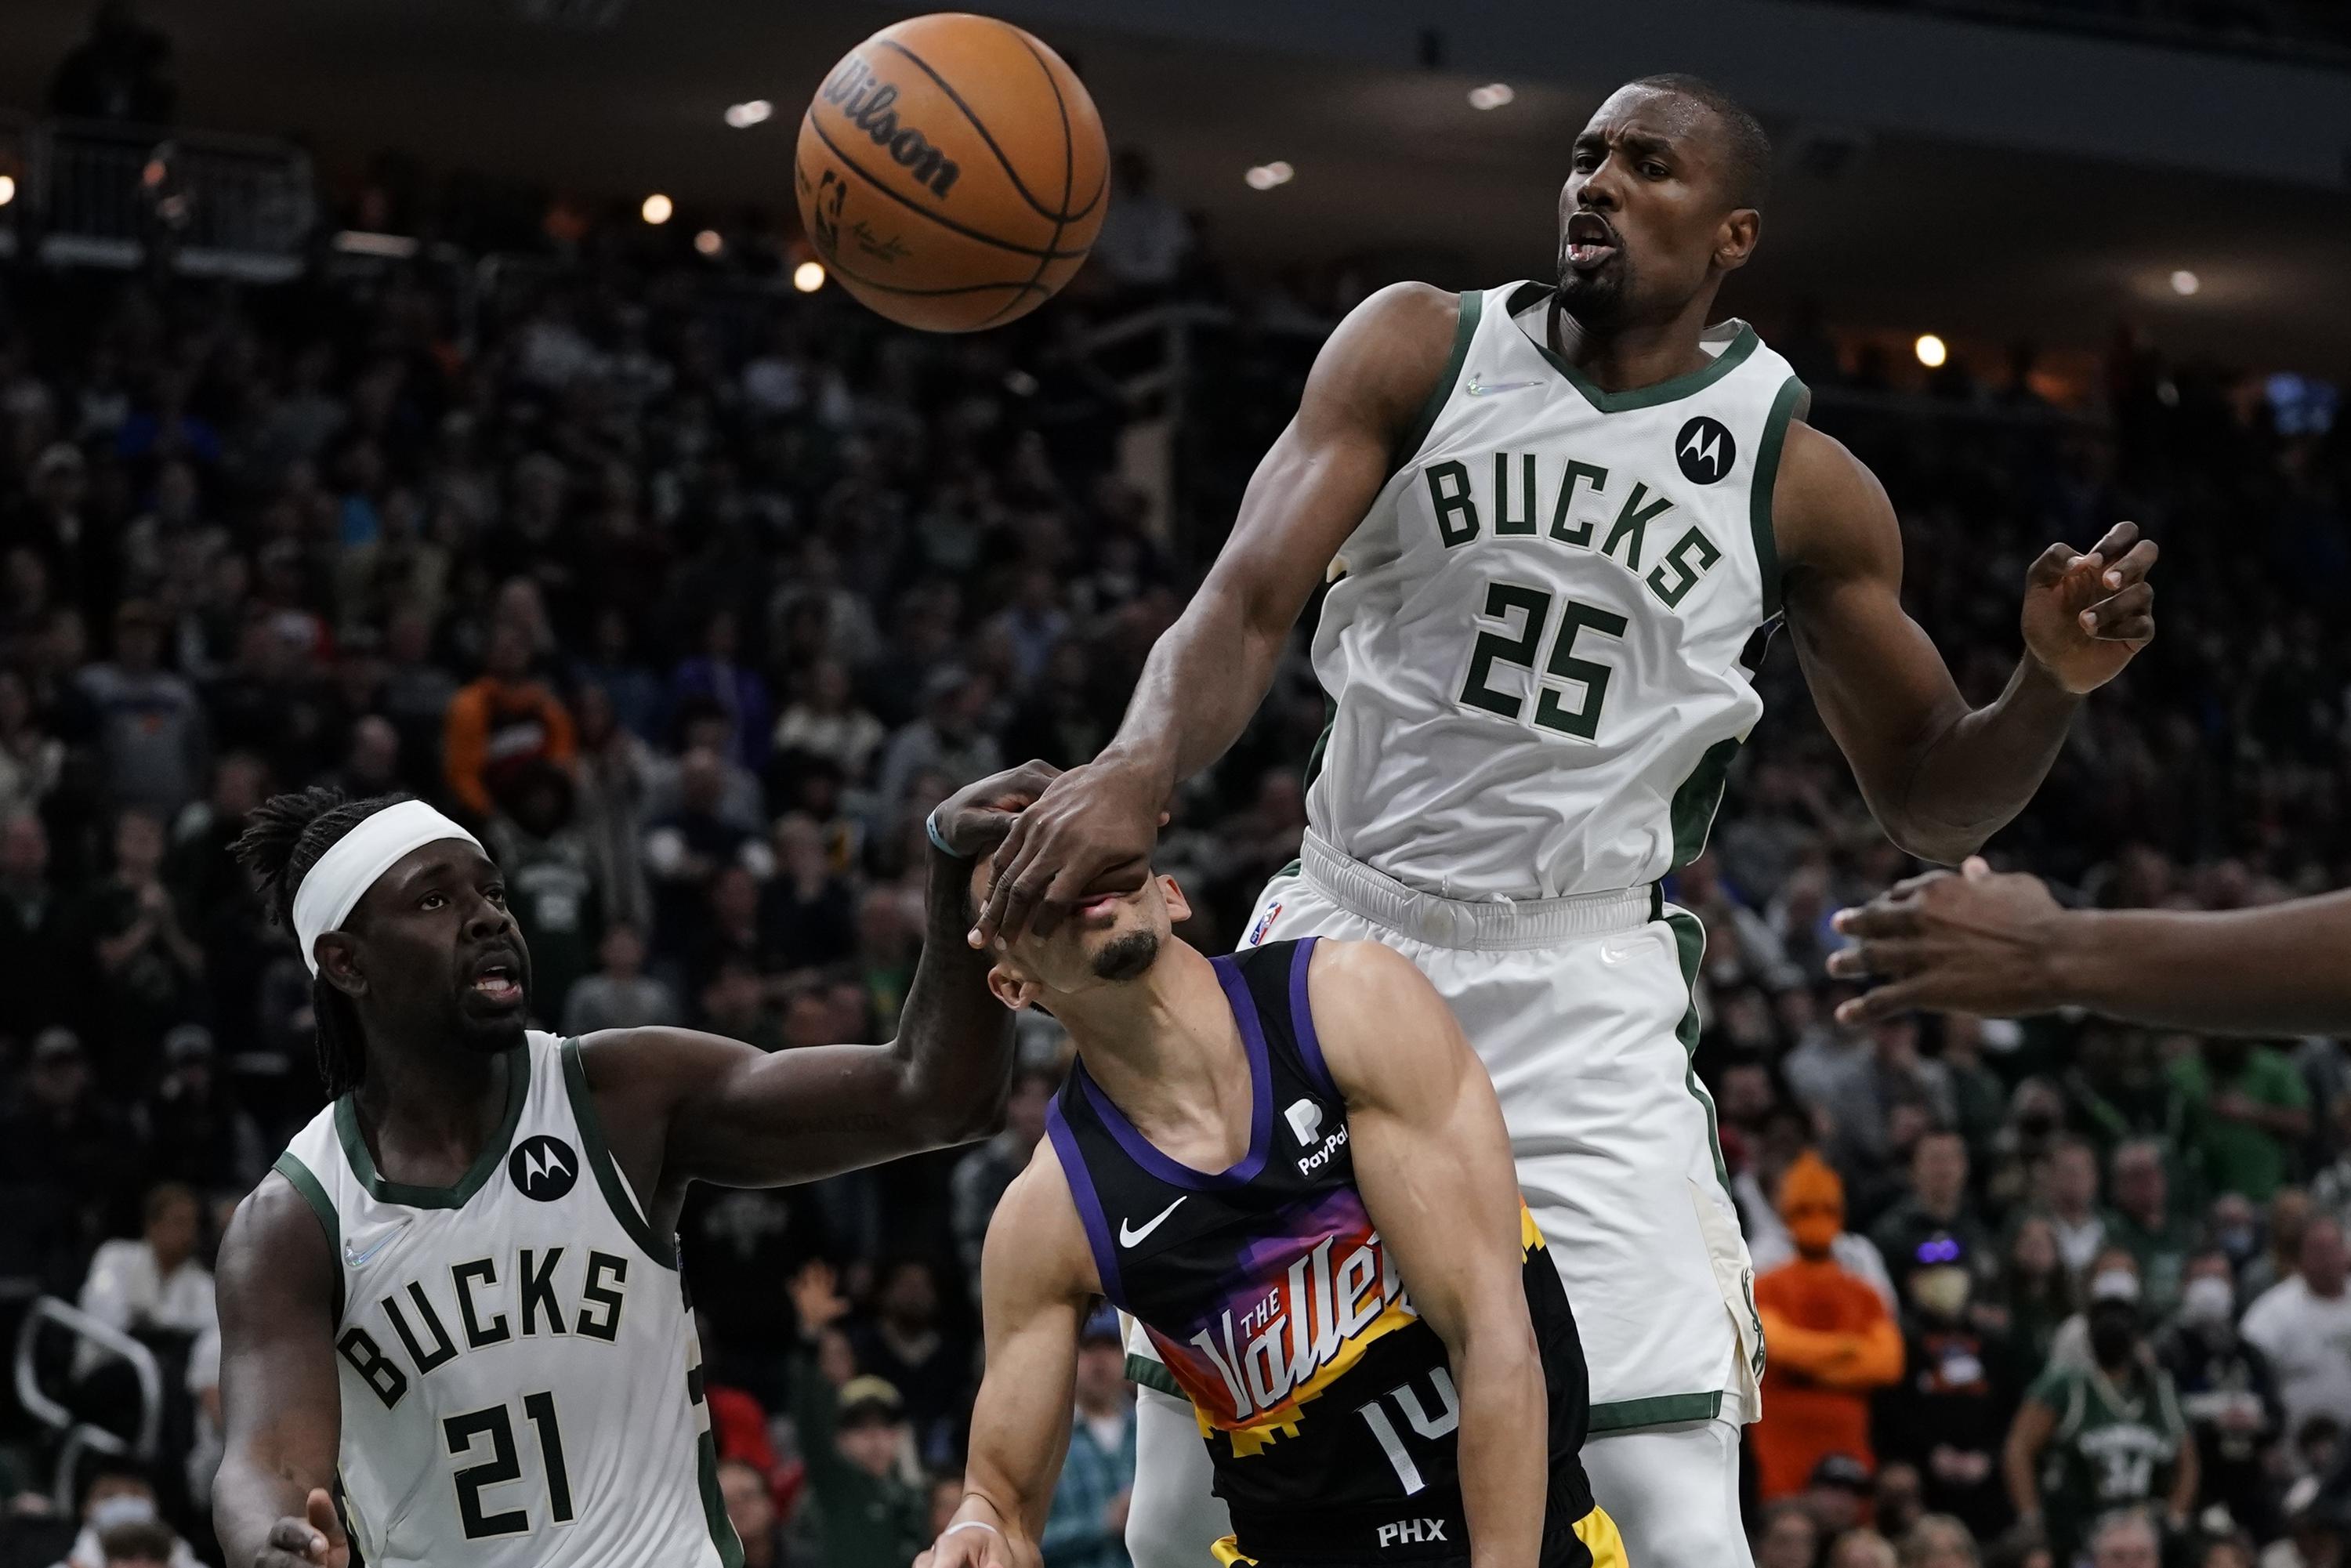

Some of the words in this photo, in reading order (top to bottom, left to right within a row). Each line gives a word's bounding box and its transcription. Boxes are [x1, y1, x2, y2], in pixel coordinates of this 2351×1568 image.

[823, 55, 960, 201] Wilson
[1424, 452, 1723, 611] BUCKS
[1455, 579, 1630, 747] 25
[1298, 1124, 1349, 1175] PayPal
[335, 1244, 629, 1410] BUCKS
[1241, 1286, 1281, 1338] THE
[438, 1390, 578, 1541] 21
[1376, 1518, 1448, 1548] PHX
